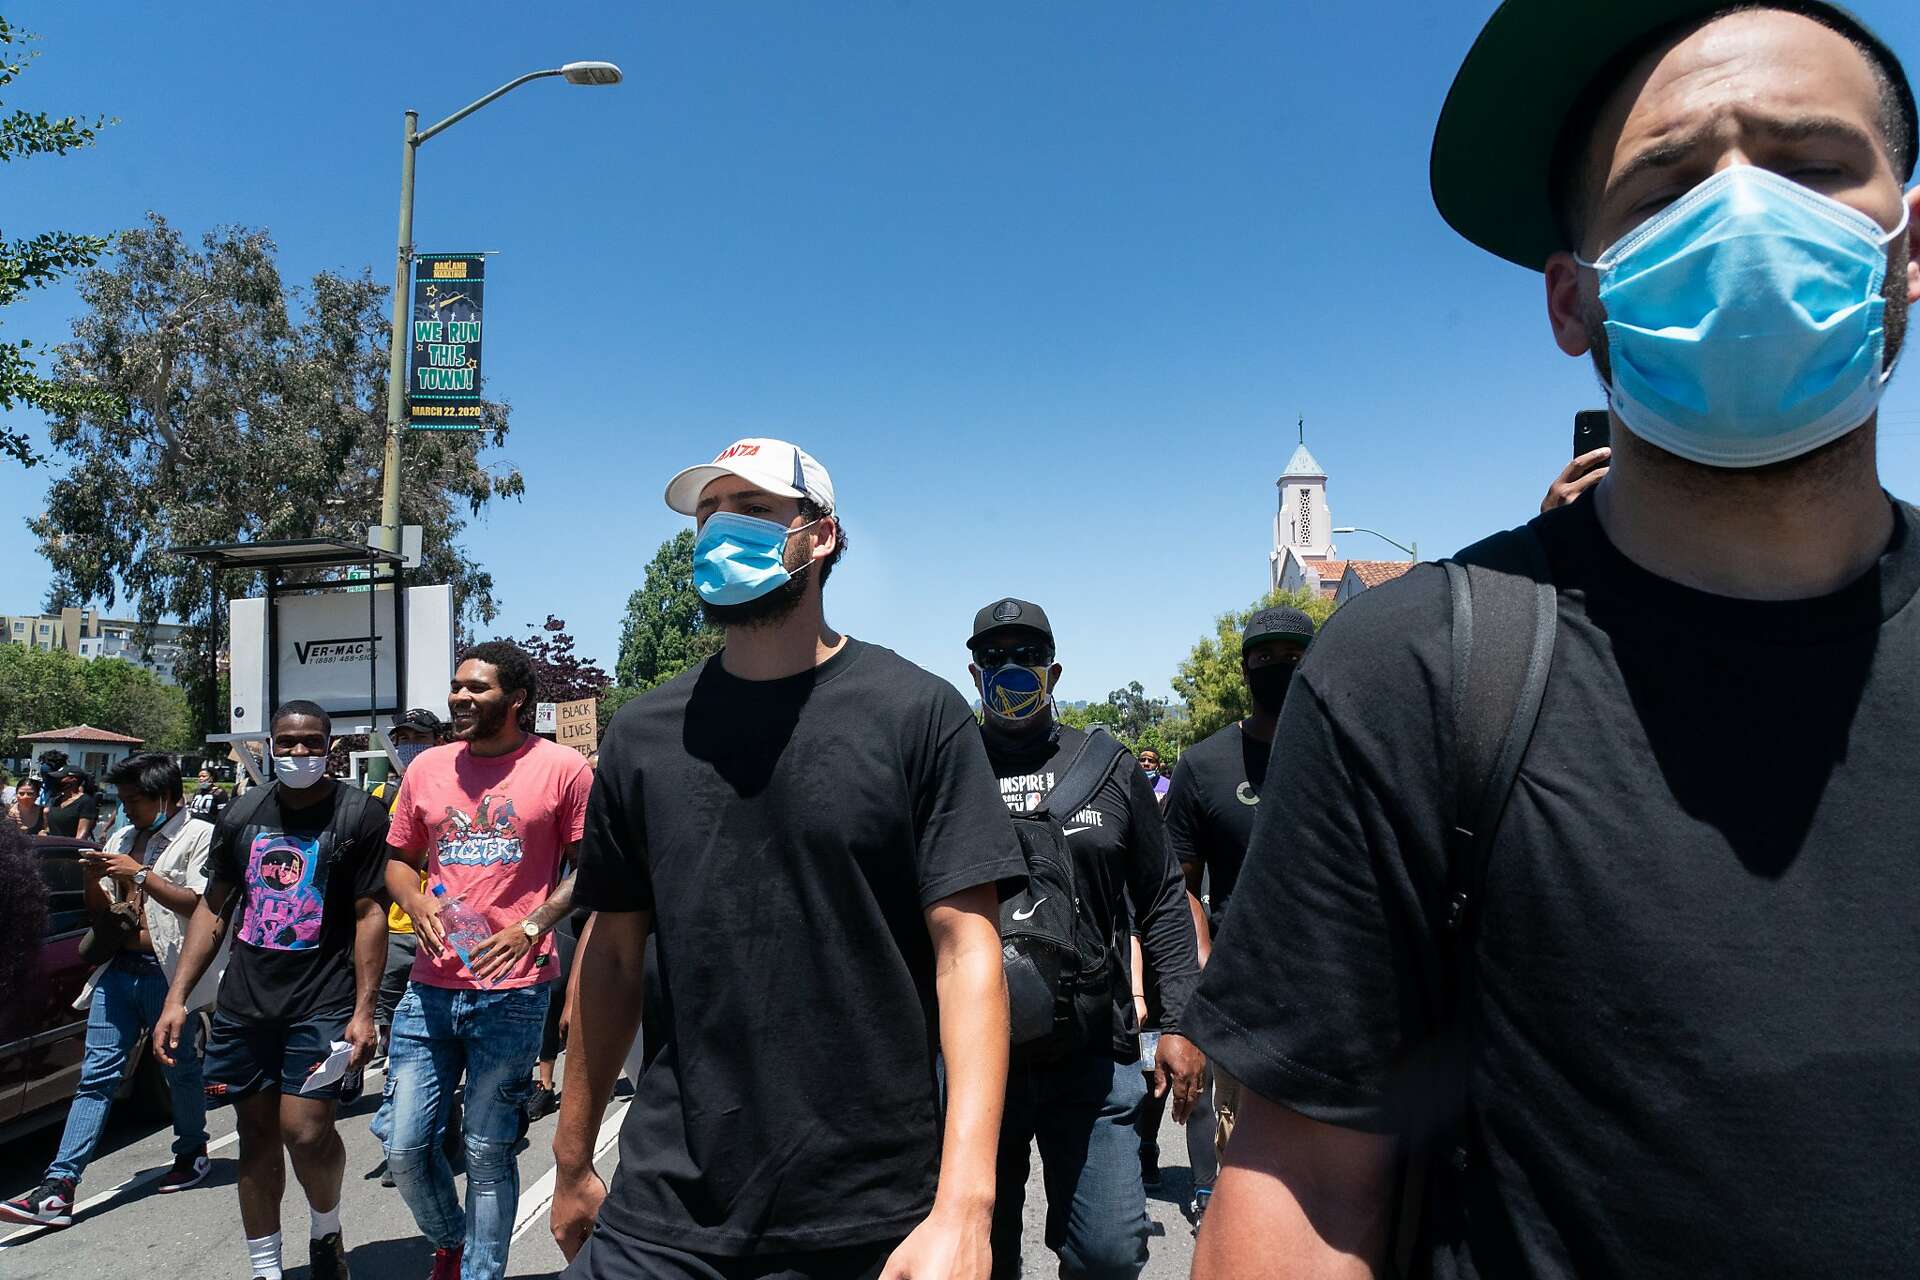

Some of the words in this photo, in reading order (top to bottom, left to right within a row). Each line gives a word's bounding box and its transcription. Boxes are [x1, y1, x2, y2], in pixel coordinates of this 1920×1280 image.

[415, 321, 443, 343] WE
[448, 321, 481, 343] RUN
[429, 345, 465, 367] THIS
[418, 368, 474, 390] TOWN!
[412, 406, 443, 416] MARCH
[294, 636, 381, 665] VER-MAC
[562, 704, 590, 719] BLACK
[562, 722, 592, 739] LIVES
[573, 743, 592, 756] TER
[1000, 774, 1046, 794] INSPIRE
[1071, 809, 1103, 827] IVATE
